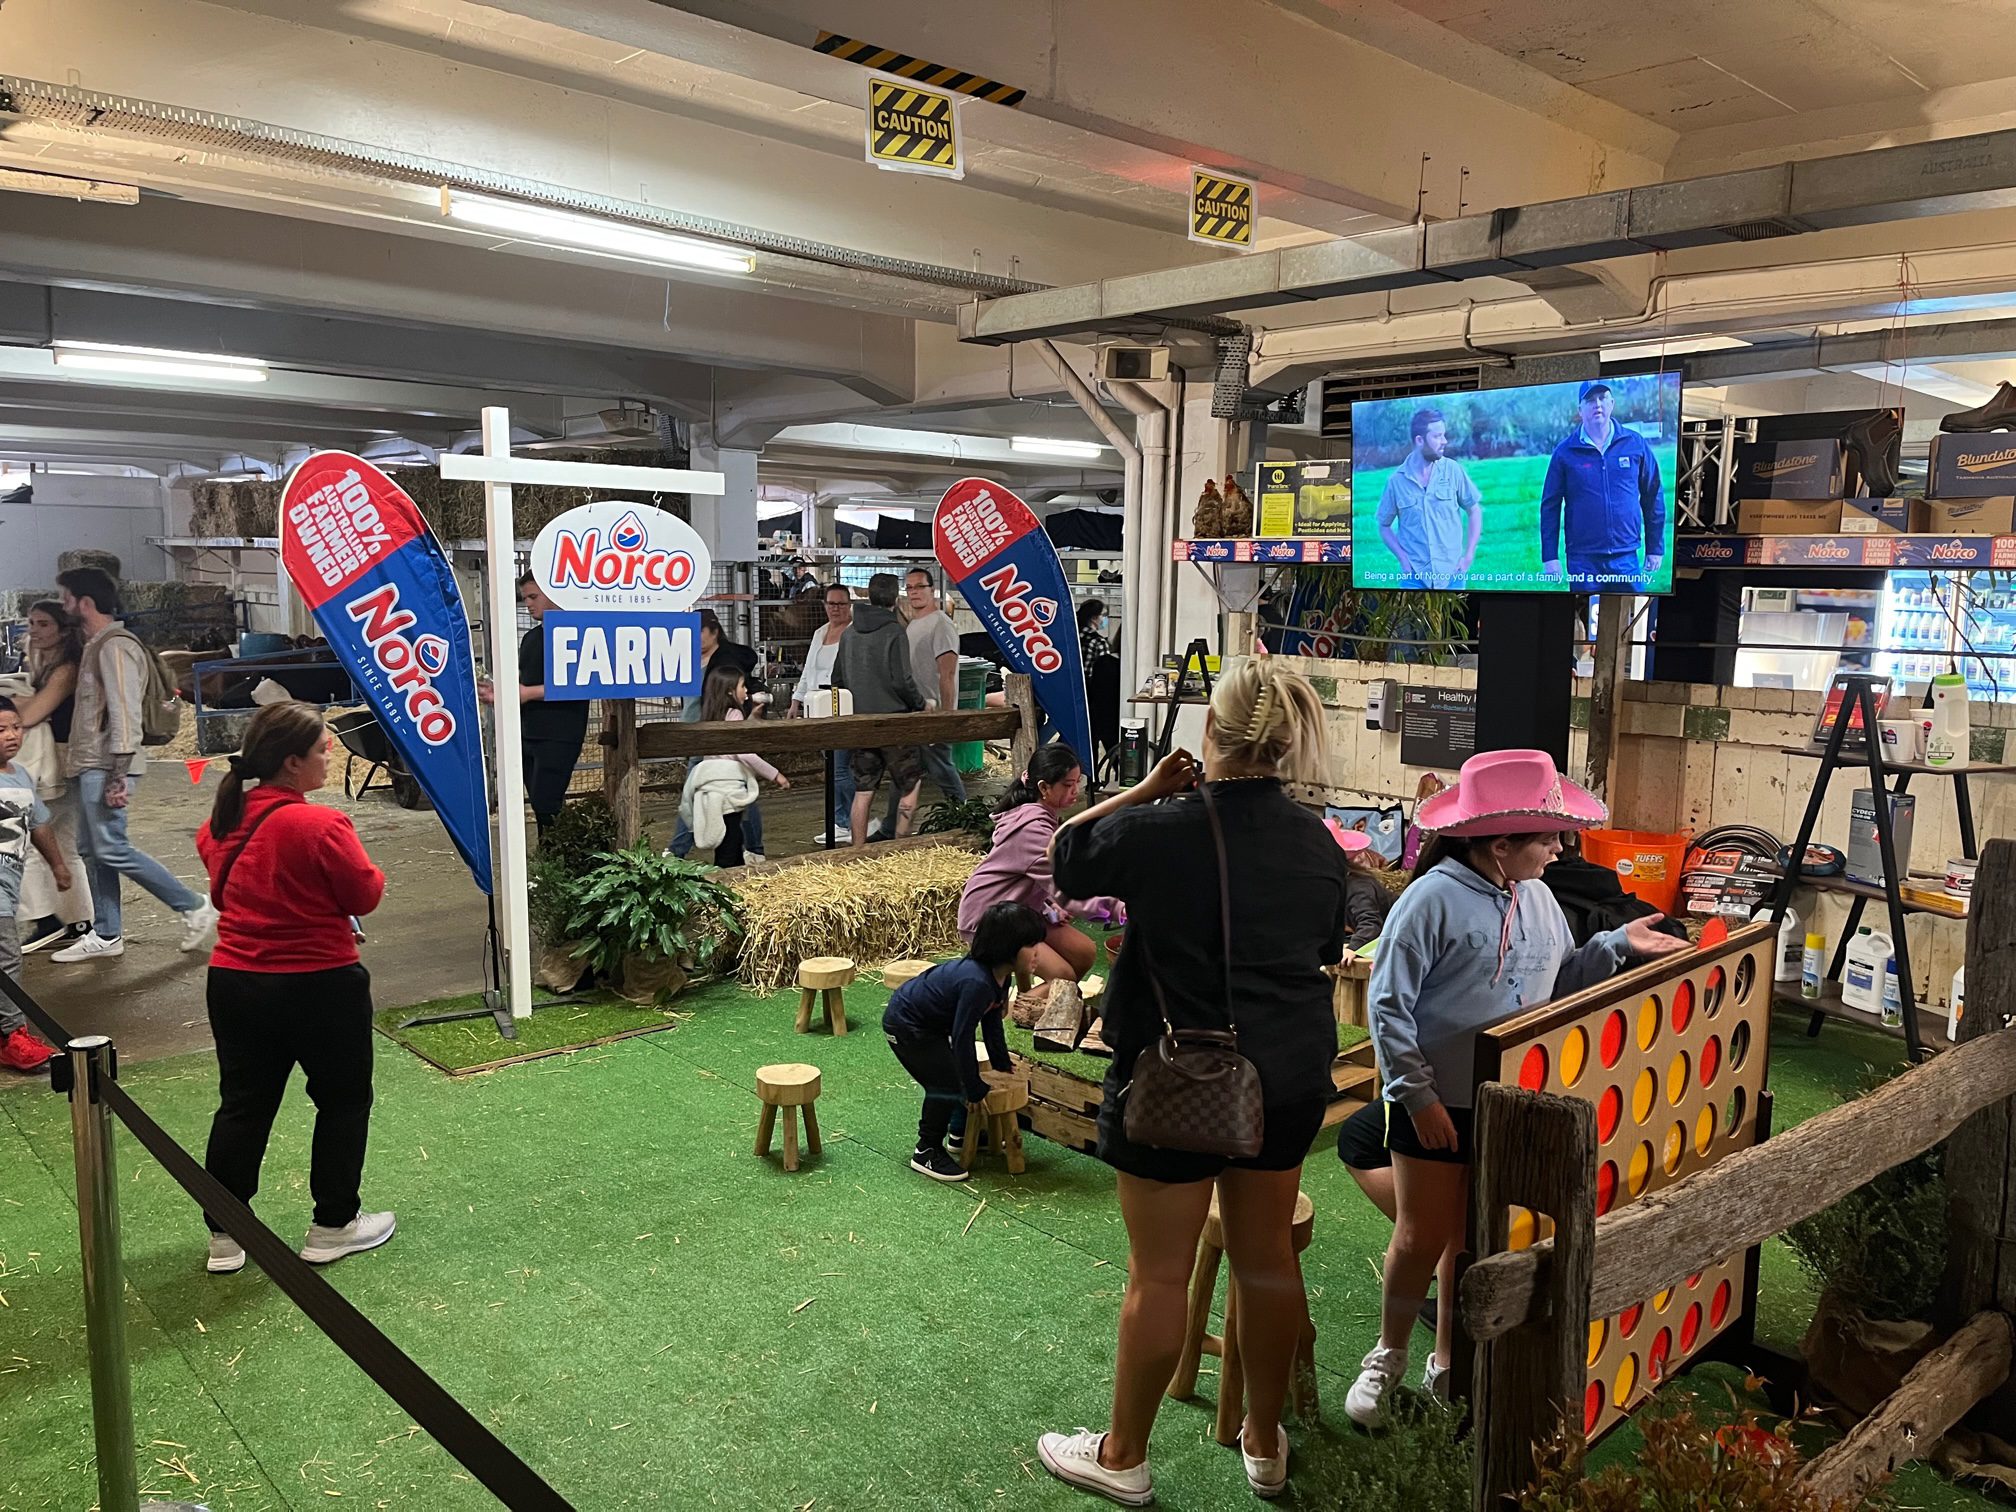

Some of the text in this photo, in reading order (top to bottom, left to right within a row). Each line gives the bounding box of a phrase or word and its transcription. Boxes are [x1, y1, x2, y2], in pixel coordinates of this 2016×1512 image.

[877, 110, 949, 140] CAUTION
[1196, 198, 1248, 222] CAUTION
[1752, 454, 1817, 474] Blundstone
[322, 484, 370, 564] AUSTRALIAN
[334, 468, 392, 556] 100%
[962, 500, 997, 553] AUSTRALIAN
[971, 489, 1014, 547] 100%
[288, 502, 344, 588] OWNED
[306, 490, 360, 577] FARMER
[939, 513, 977, 569] OWNED
[951, 505, 990, 560] FARMER
[1867, 539, 1892, 548] 100%
[551, 529, 694, 590] Norco
[1206, 545, 1229, 557] Norco
[1271, 545, 1296, 557] Norco
[1694, 544, 1734, 558] Norco
[1808, 543, 1850, 559] Norco
[1931, 543, 1978, 559] Norco
[1364, 571, 1387, 581] Being
[1396, 572, 1413, 582] part
[1415, 571, 1423, 580] of
[1425, 572, 1451, 581] Norco
[1453, 574, 1469, 583] you
[1495, 572, 1514, 584] part
[1515, 572, 1525, 582] of
[1527, 574, 1533, 582] a
[1536, 572, 1563, 584] family
[1566, 573, 1585, 582] and
[1596, 572, 1656, 585] community.
[594, 594, 652, 604] SINCE 1895
[979, 563, 1062, 674] Norco
[987, 613, 1004, 636] SINCE
[346, 583, 456, 746] Norco
[552, 626, 692, 686] FARM
[357, 656, 402, 724] SINCE 1895
[1438, 690, 1472, 705] Healthy
[1635, 854, 1665, 863] TUFFYS
